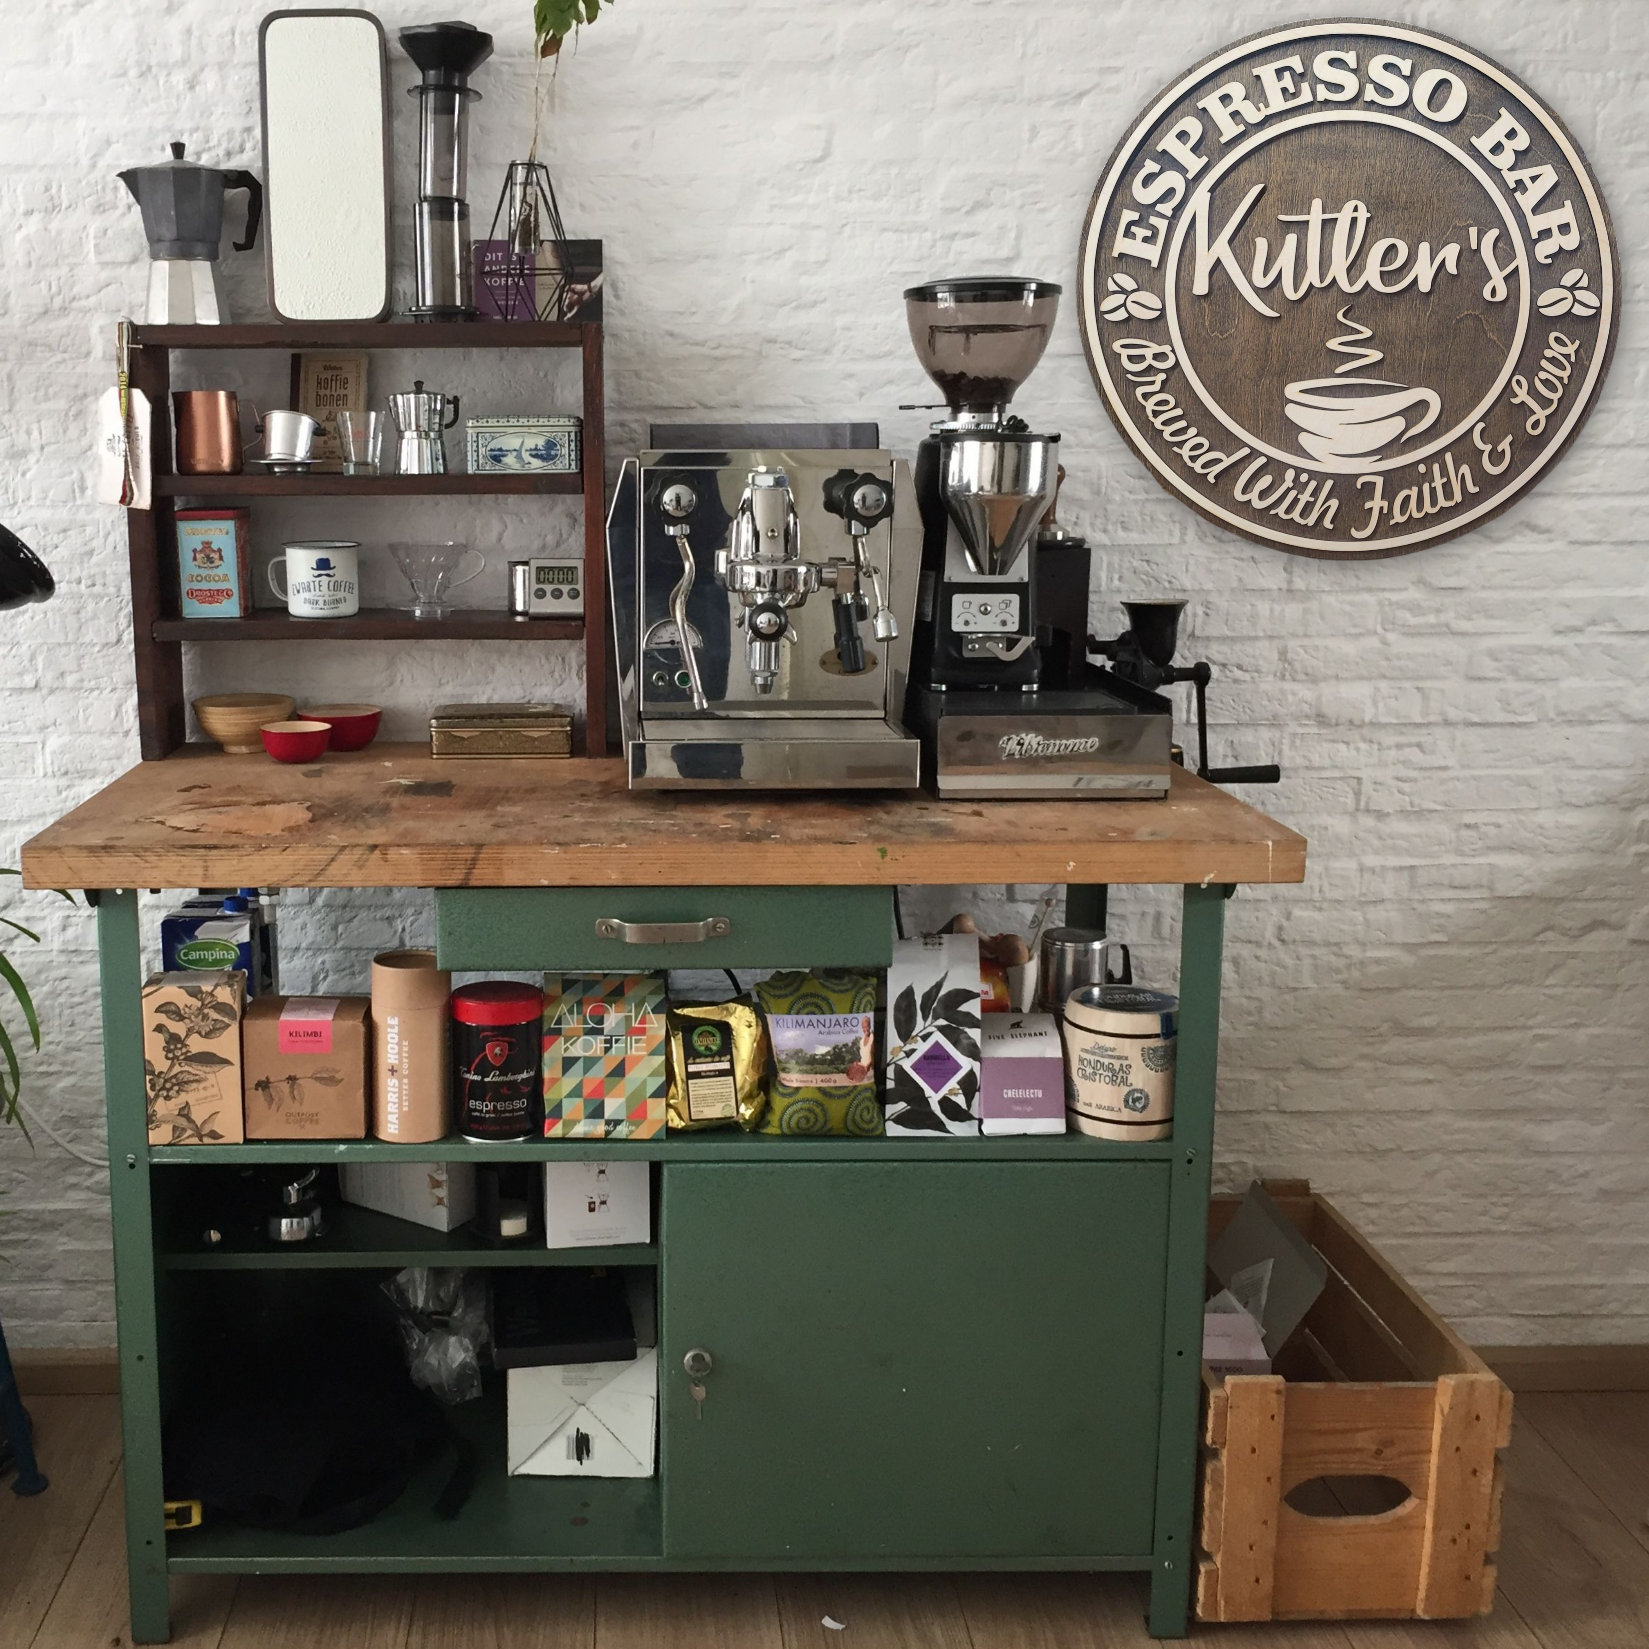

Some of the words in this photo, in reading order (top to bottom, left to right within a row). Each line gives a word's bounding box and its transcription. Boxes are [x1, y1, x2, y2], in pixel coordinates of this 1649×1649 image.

[1111, 50, 1469, 268] ESPRESSO
[1470, 107, 1583, 266] BAR
[484, 252, 503, 261] DIT
[1191, 183, 1521, 318] Kutler's
[316, 374, 349, 393] koffie
[315, 391, 349, 408] bonen
[1112, 337, 1250, 485] Brewed
[1234, 459, 1340, 529] With
[1350, 451, 1480, 539] Faith
[1472, 421, 1514, 476] &
[1510, 331, 1581, 436] Love
[187, 573, 230, 583] COCOA
[180, 948, 235, 961] Campina
[551, 1002, 658, 1028] ALOHA
[775, 1017, 860, 1029] KILIMANJARO
[387, 1016, 399, 1064] HOOLE
[1011, 1031, 1048, 1039] ELEPHANT
[561, 1036, 647, 1055] KOFFIE
[1078, 1055, 1132, 1075] HONDURAS
[1077, 1068, 1133, 1087] CRISTOBAL
[387, 1078, 399, 1134] HARRIS
[469, 1099, 527, 1113] espresso
